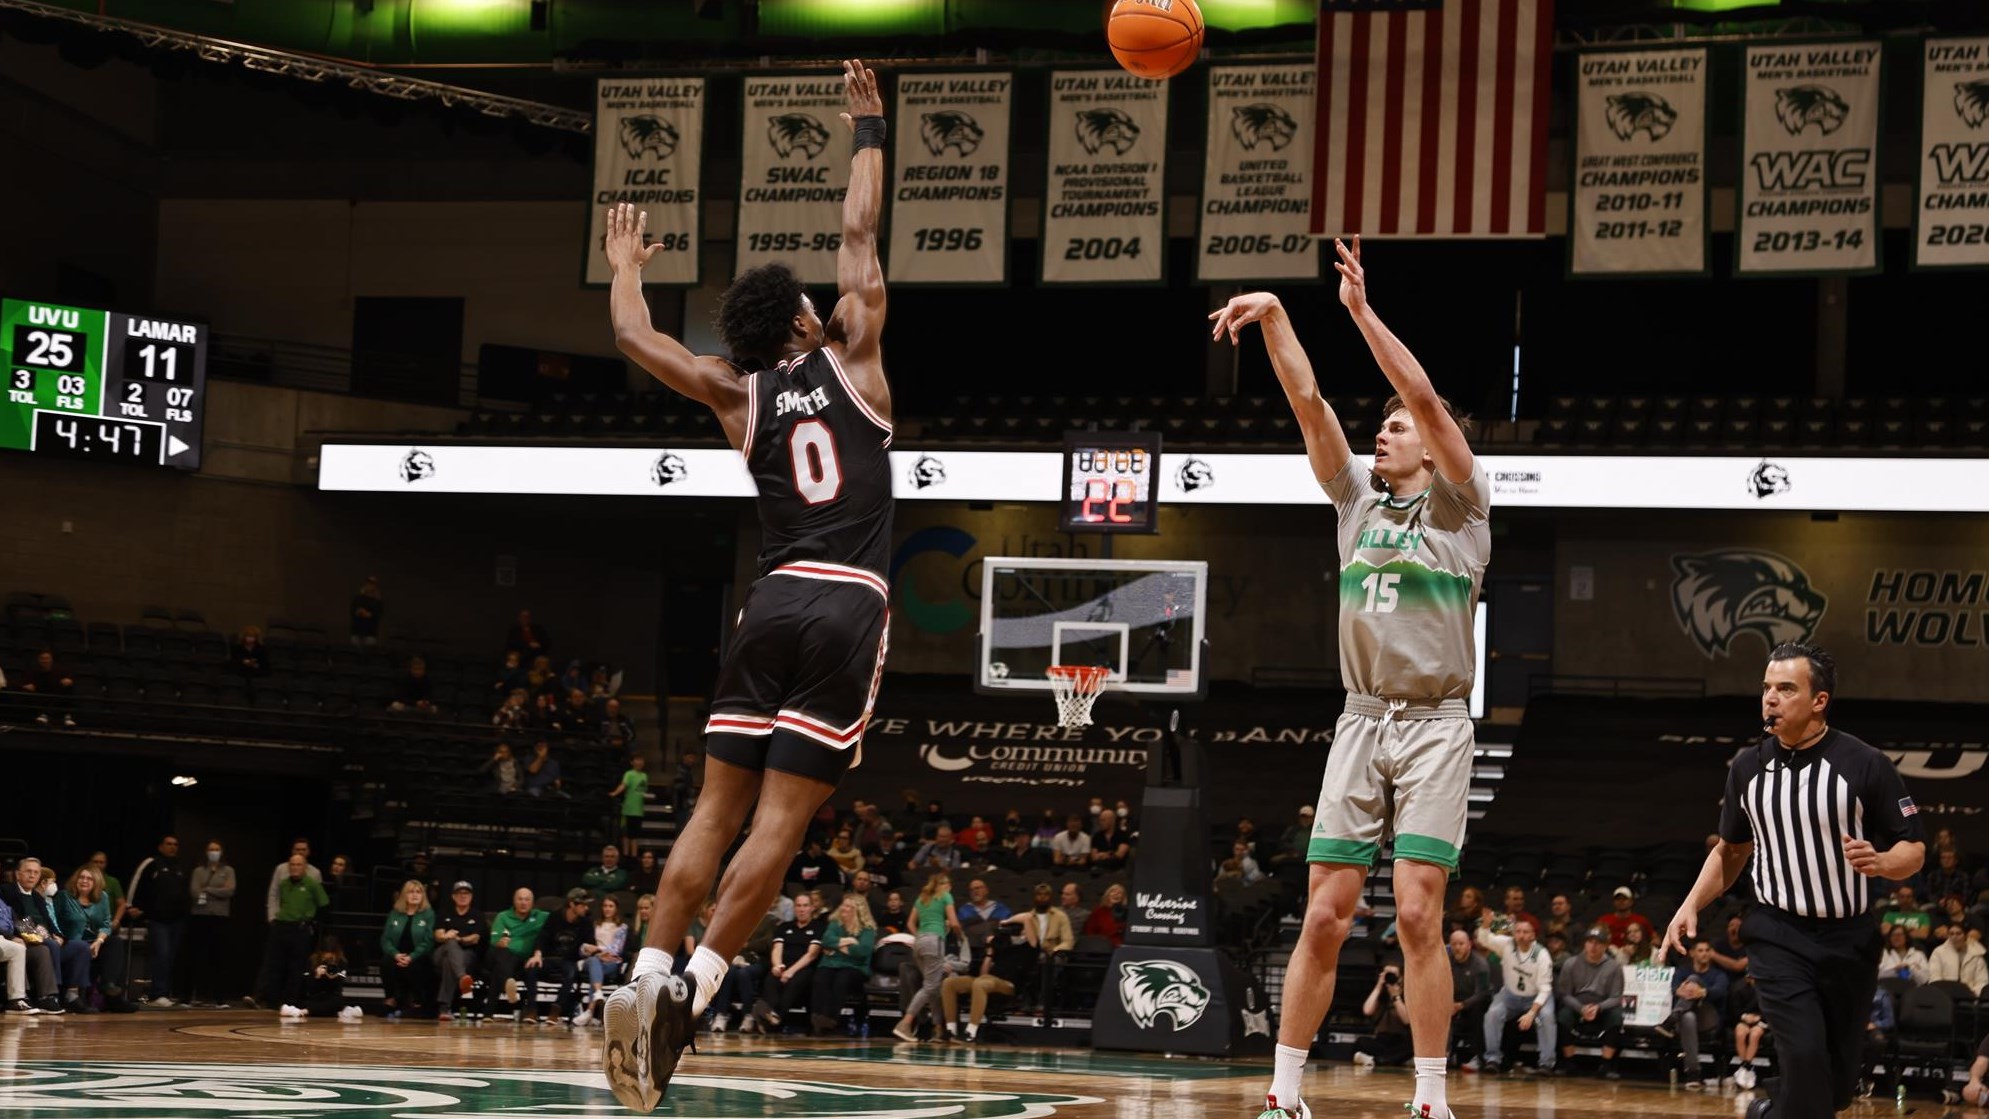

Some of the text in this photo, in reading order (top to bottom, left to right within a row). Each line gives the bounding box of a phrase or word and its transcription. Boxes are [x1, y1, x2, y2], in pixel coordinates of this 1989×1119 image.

[1751, 48, 1878, 67] UTAH VALLEY
[1929, 46, 1980, 60] UTAH
[1583, 57, 1702, 75] UTAH VALLEY
[1797, 67, 1869, 77] BASKETBALL
[901, 80, 1008, 93] UTAH VALLEY
[1055, 78, 1098, 90] UTAH
[1213, 71, 1315, 86] UTAH VALLE
[1627, 73, 1695, 84] BASKETBALL
[601, 84, 702, 98] UTAH VALLEY
[748, 82, 846, 96] UTAH VALLE
[1055, 164, 1088, 175] NCAA
[1092, 162, 1149, 174] DIVISION
[1240, 160, 1288, 171] UNITED
[1613, 155, 1638, 167] WEST
[1641, 152, 1698, 166] CONFERENCE
[624, 169, 671, 185] ICAC
[766, 167, 828, 184] SWAC
[904, 165, 1000, 181] REGION 18
[1580, 168, 1700, 186] CHAMPIONS
[1750, 148, 1871, 190] WAC
[1062, 176, 1146, 188] PROVISIONAL
[1220, 173, 1303, 184] BASKETBALL
[597, 189, 695, 204] CHAMPIONS
[745, 188, 847, 202] CHAMPIONS
[898, 186, 1003, 201] CHAMPIONS
[1062, 188, 1150, 201] TOURNAMENT
[1236, 185, 1286, 197] LEAGUE
[1051, 201, 1159, 218] CHAMPIONS
[1596, 191, 1683, 211] 2010-11
[1747, 197, 1871, 217] CHAMPIONS
[1925, 192, 1989, 210] CHAM
[1595, 220, 1682, 239] 2011-12
[748, 232, 840, 251] 1995-96
[915, 227, 983, 251] 1996
[1206, 234, 1312, 255] 2006-07
[1753, 229, 1863, 252] 2013-14
[1065, 237, 1141, 260] 2004
[28, 305, 79, 328] UVU
[127, 318, 197, 344] LAMAR
[25, 331, 73, 367] 25
[139, 344, 177, 380] 11
[15, 370, 30, 389] 3
[57, 375, 85, 395] 03
[8, 389, 38, 404] TOL
[127, 383, 143, 402] 2
[166, 387, 194, 407] 07
[56, 395, 84, 409] FLS
[119, 402, 148, 417] TOL
[166, 408, 192, 422] FLS
[56, 419, 142, 456] 4:47
[788, 418, 844, 505] 0
[1082, 478, 1136, 522] 22
[1356, 528, 1422, 550] ALLEY
[1361, 573, 1401, 613] 15
[1868, 571, 1989, 603] HOM
[926, 719, 1088, 742] WHERE
[990, 761, 1088, 773] CREDIT UNION
[1136, 892, 1197, 910] Wolverine
[1145, 908, 1185, 925] Crossing
